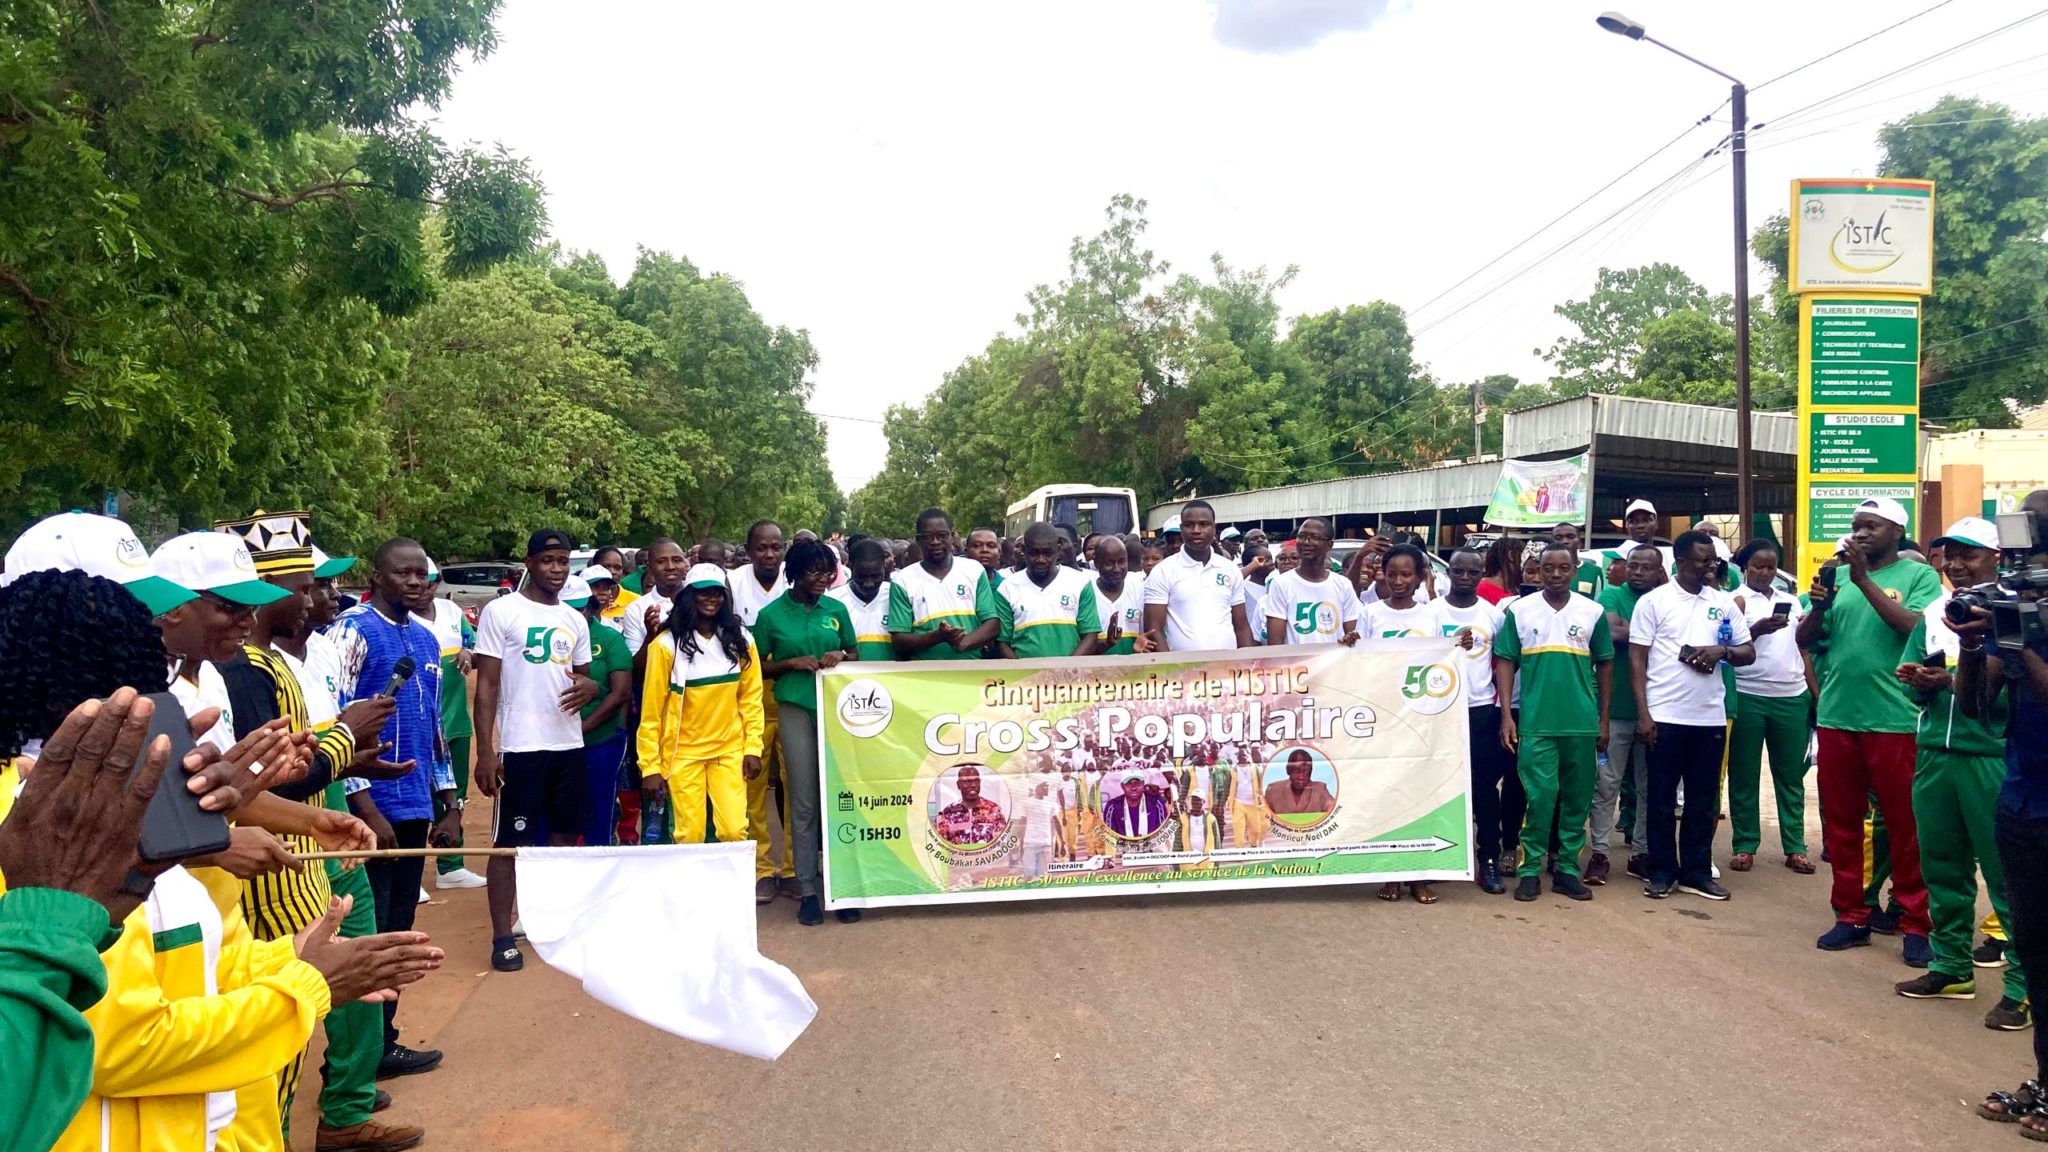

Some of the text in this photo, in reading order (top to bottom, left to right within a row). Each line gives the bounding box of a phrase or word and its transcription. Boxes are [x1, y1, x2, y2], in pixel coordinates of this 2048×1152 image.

[1816, 307, 1914, 316] FILIERES DE FORMATION
[1836, 416, 1895, 424] STUDIO ECOLE
[1815, 489, 1846, 497] CYCLE
[1848, 489, 1860, 497] DE
[1293, 601, 1340, 635] 50
[523, 626, 576, 665] 50
[982, 665, 1310, 713] Cinquantenaire de l'ISTIC
[1401, 663, 1457, 699] 50
[924, 698, 1377, 758] Cross Populaire
[858, 795, 914, 811] 14 juin 2024
[859, 827, 901, 842] 15H30
[1271, 827, 1304, 842] Monsieur
[1323, 822, 1339, 837] DAH
[925, 835, 1019, 867] Dr Boubakar SAVADOGO
[983, 873, 1024, 889] ISTIC
[1037, 873, 1053, 887] 50
[1056, 874, 1079, 885] ans
[1083, 869, 1162, 884] d'excellence
[1166, 870, 1183, 880] au
[1186, 865, 1232, 879] service
[1234, 865, 1250, 876] de
[1253, 864, 1265, 876] la
[1271, 862, 1314, 875] Nation
[1048, 861, 1084, 870] Itinéraire
